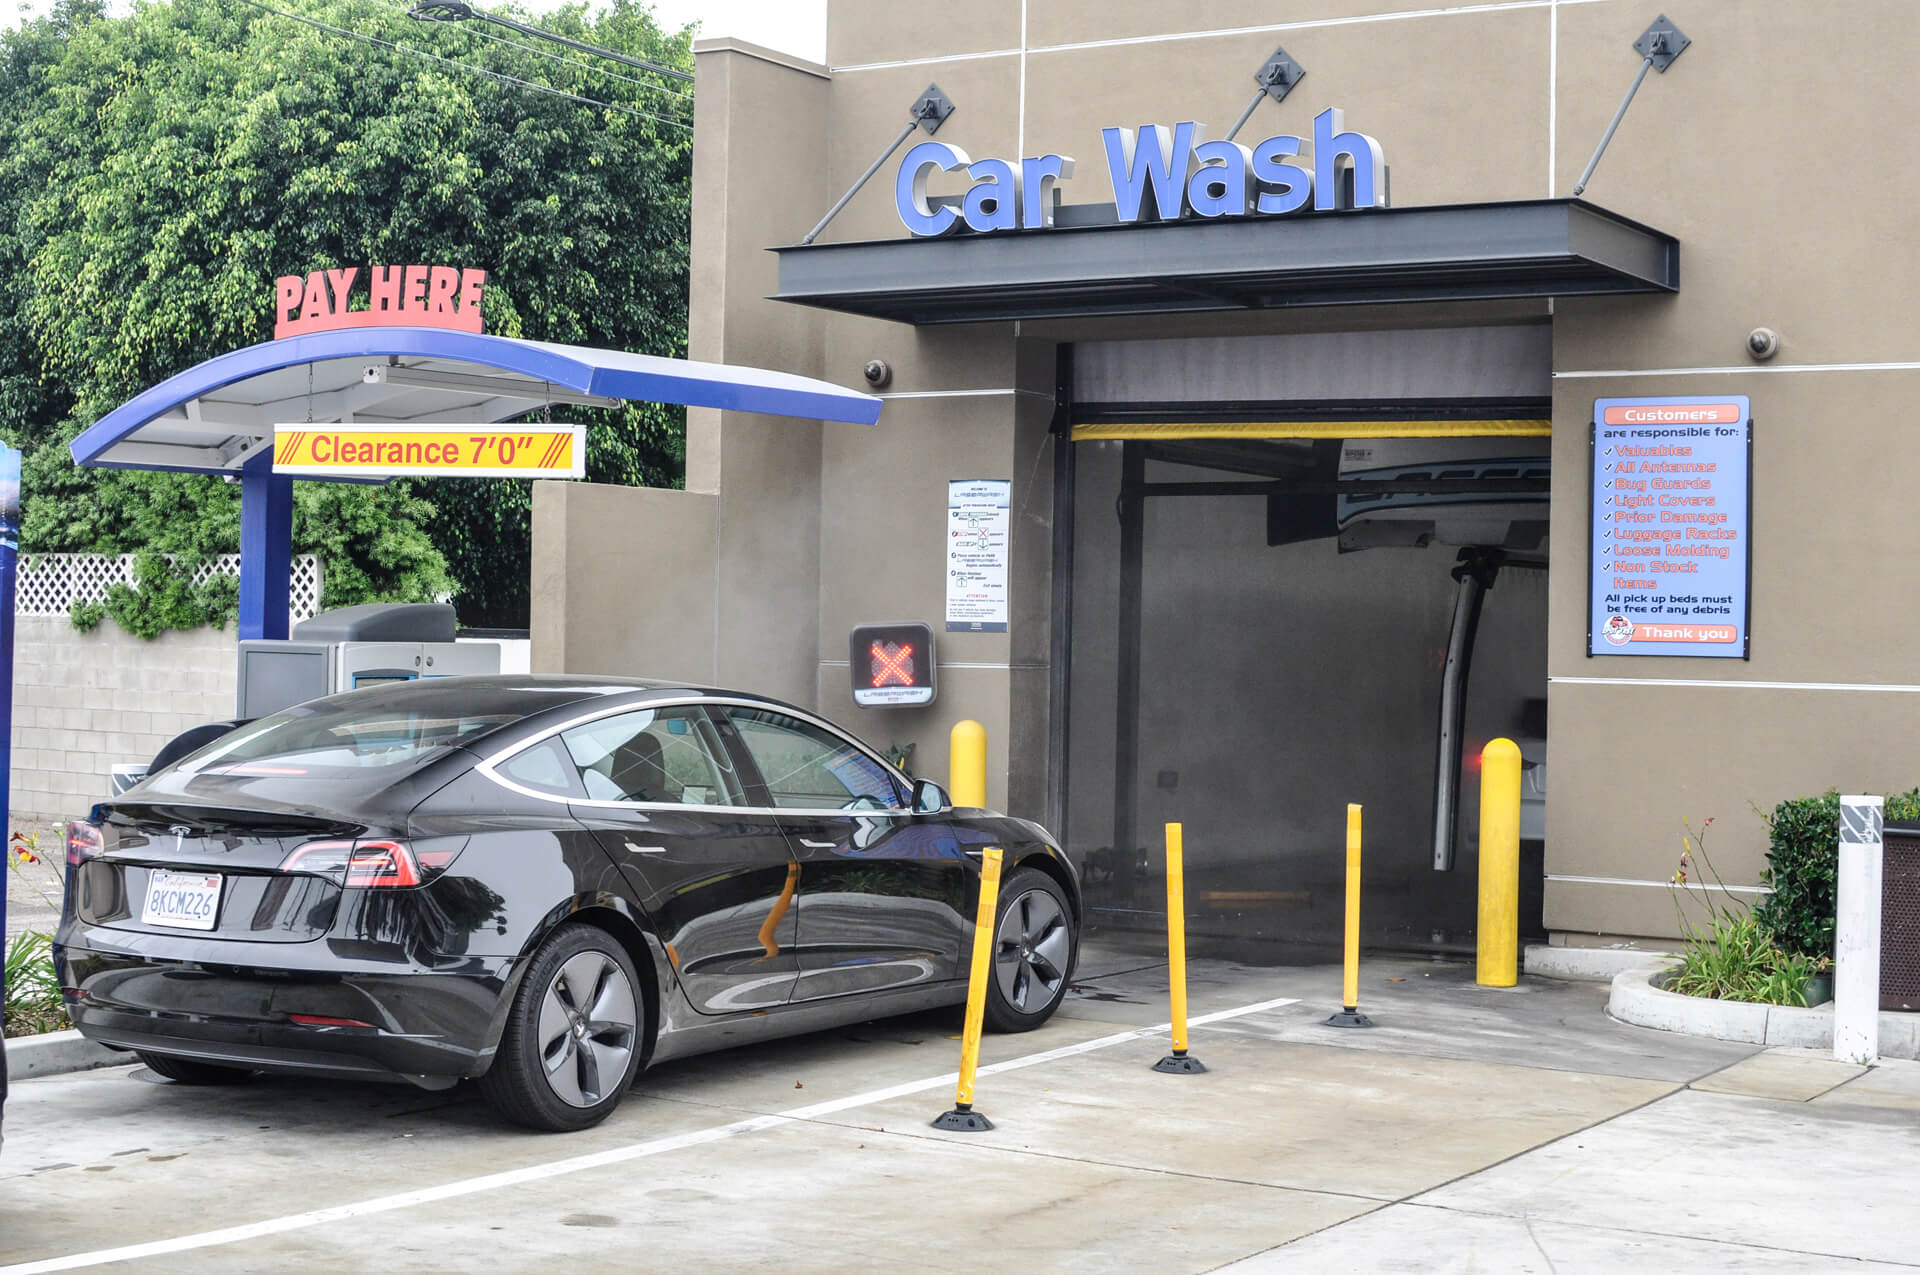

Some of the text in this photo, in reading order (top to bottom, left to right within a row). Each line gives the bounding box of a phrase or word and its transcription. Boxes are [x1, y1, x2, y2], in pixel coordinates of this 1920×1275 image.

[896, 106, 1386, 237] Car Wash
[275, 264, 488, 323] PAY HERE
[1624, 409, 1718, 421] Customers
[1604, 426, 1740, 439] are responsible for:
[311, 435, 459, 464] Clearance
[1615, 444, 1693, 457] Valuables
[1614, 461, 1717, 473] All Antennas
[1615, 477, 1711, 492] Bug Guards
[1614, 494, 1716, 509] Light Covers
[1614, 511, 1727, 525] Prior Damage
[1614, 528, 1738, 542] Luggage Racks
[1614, 544, 1730, 559] Loose Molding
[1614, 561, 1698, 573] Non Stock
[1614, 577, 1657, 589] Items
[1604, 594, 1733, 604] All pick up beds must
[1607, 604, 1731, 615] be free of any debris
[1642, 627, 1694, 638] Thank
[1698, 629, 1729, 641] you
[151, 889, 214, 916] 8KCM226
